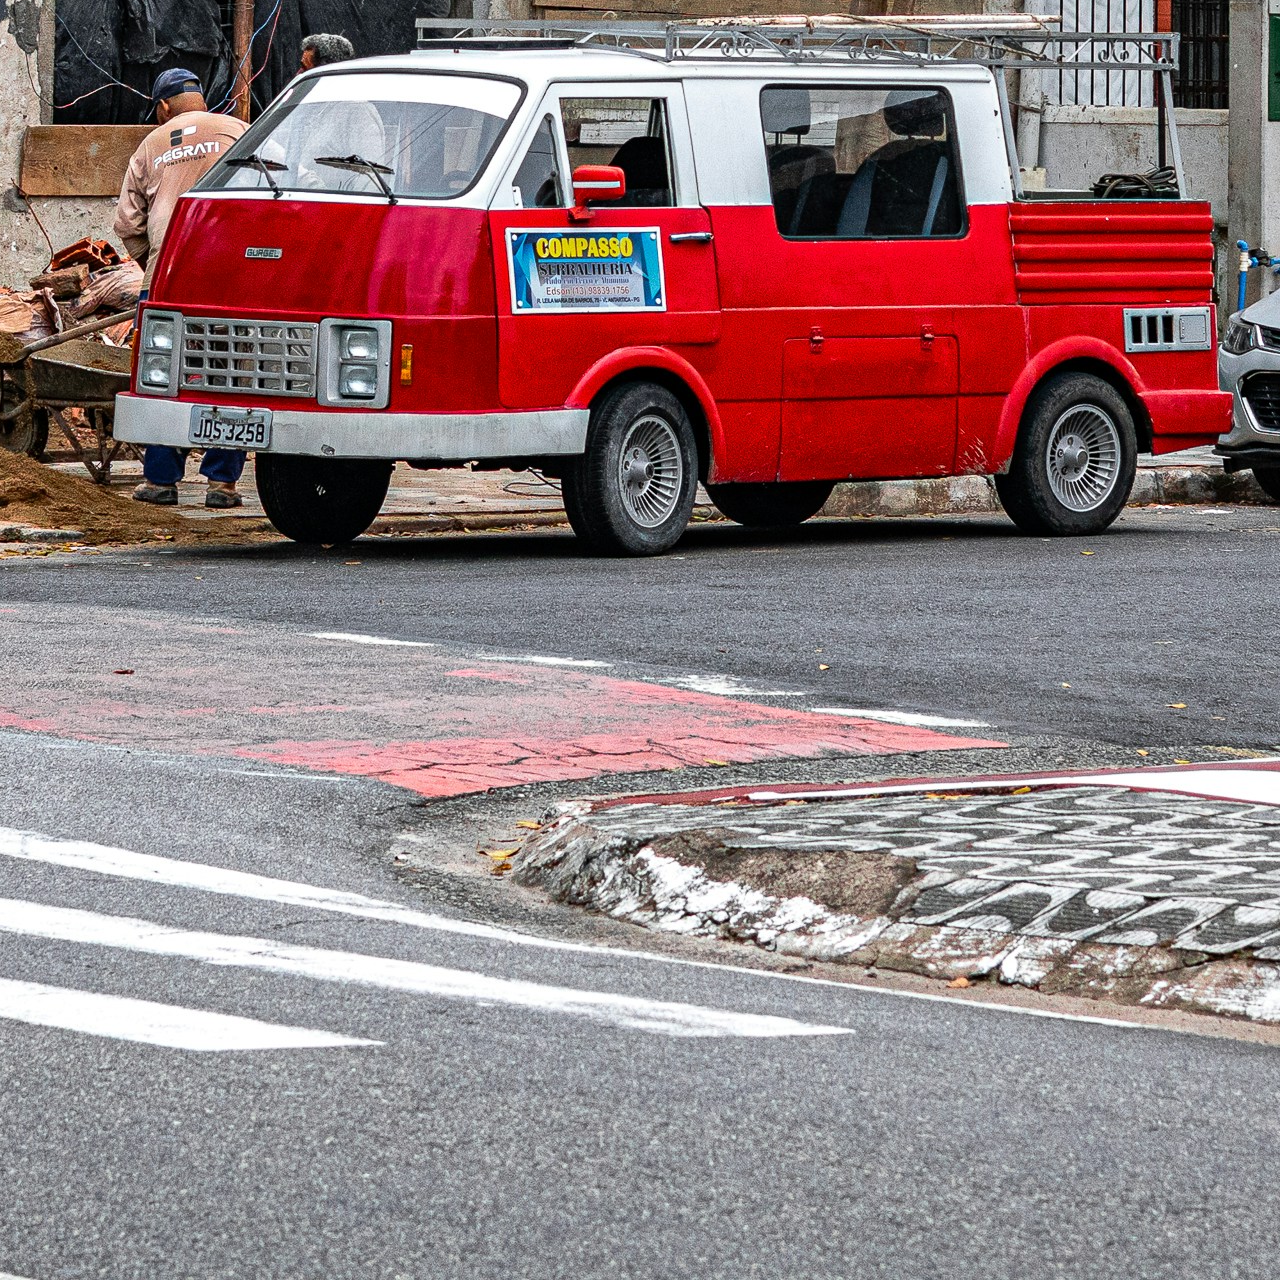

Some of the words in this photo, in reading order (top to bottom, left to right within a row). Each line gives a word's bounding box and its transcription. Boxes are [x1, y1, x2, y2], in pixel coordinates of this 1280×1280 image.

[153, 141, 220, 170] PEGRATI
[247, 249, 279, 257] GURGEL
[536, 237, 634, 258] COMPASSO
[539, 262, 633, 276] SERRALHERIA
